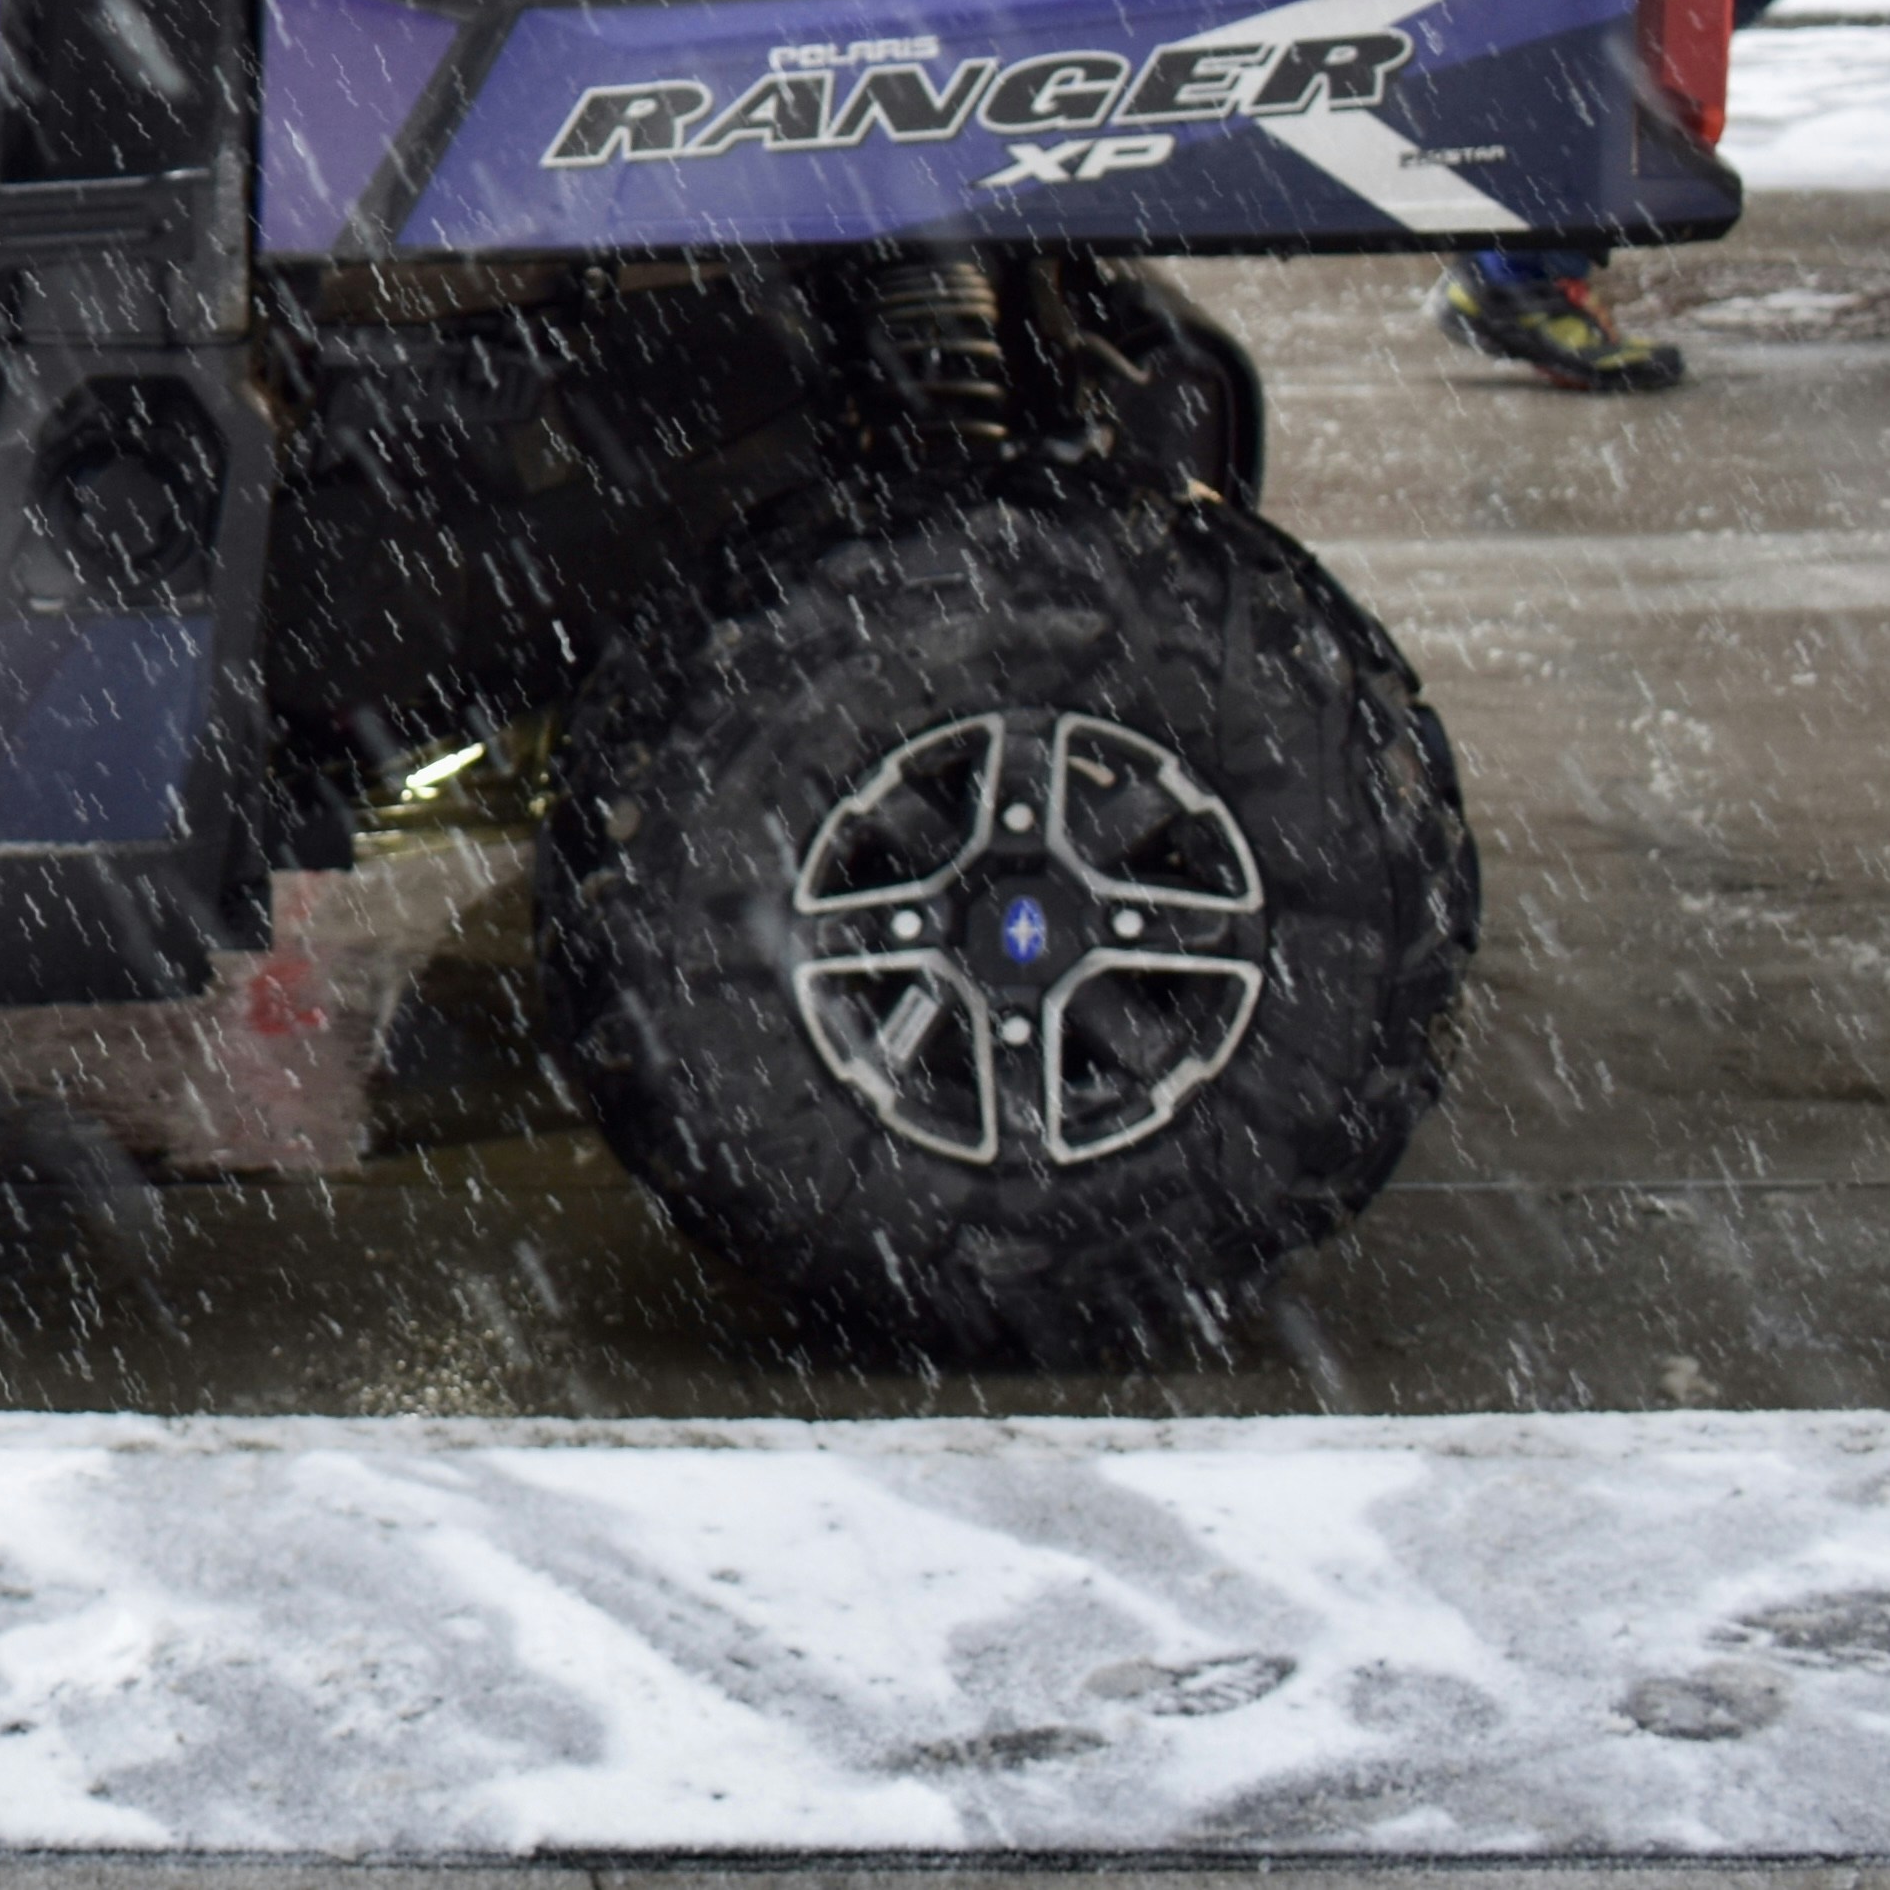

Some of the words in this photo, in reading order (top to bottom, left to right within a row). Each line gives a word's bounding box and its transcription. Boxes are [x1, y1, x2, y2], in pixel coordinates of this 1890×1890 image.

[768, 35, 940, 70] POLARIS
[539, 27, 1415, 169] RANGER
[970, 133, 1175, 188] XP
